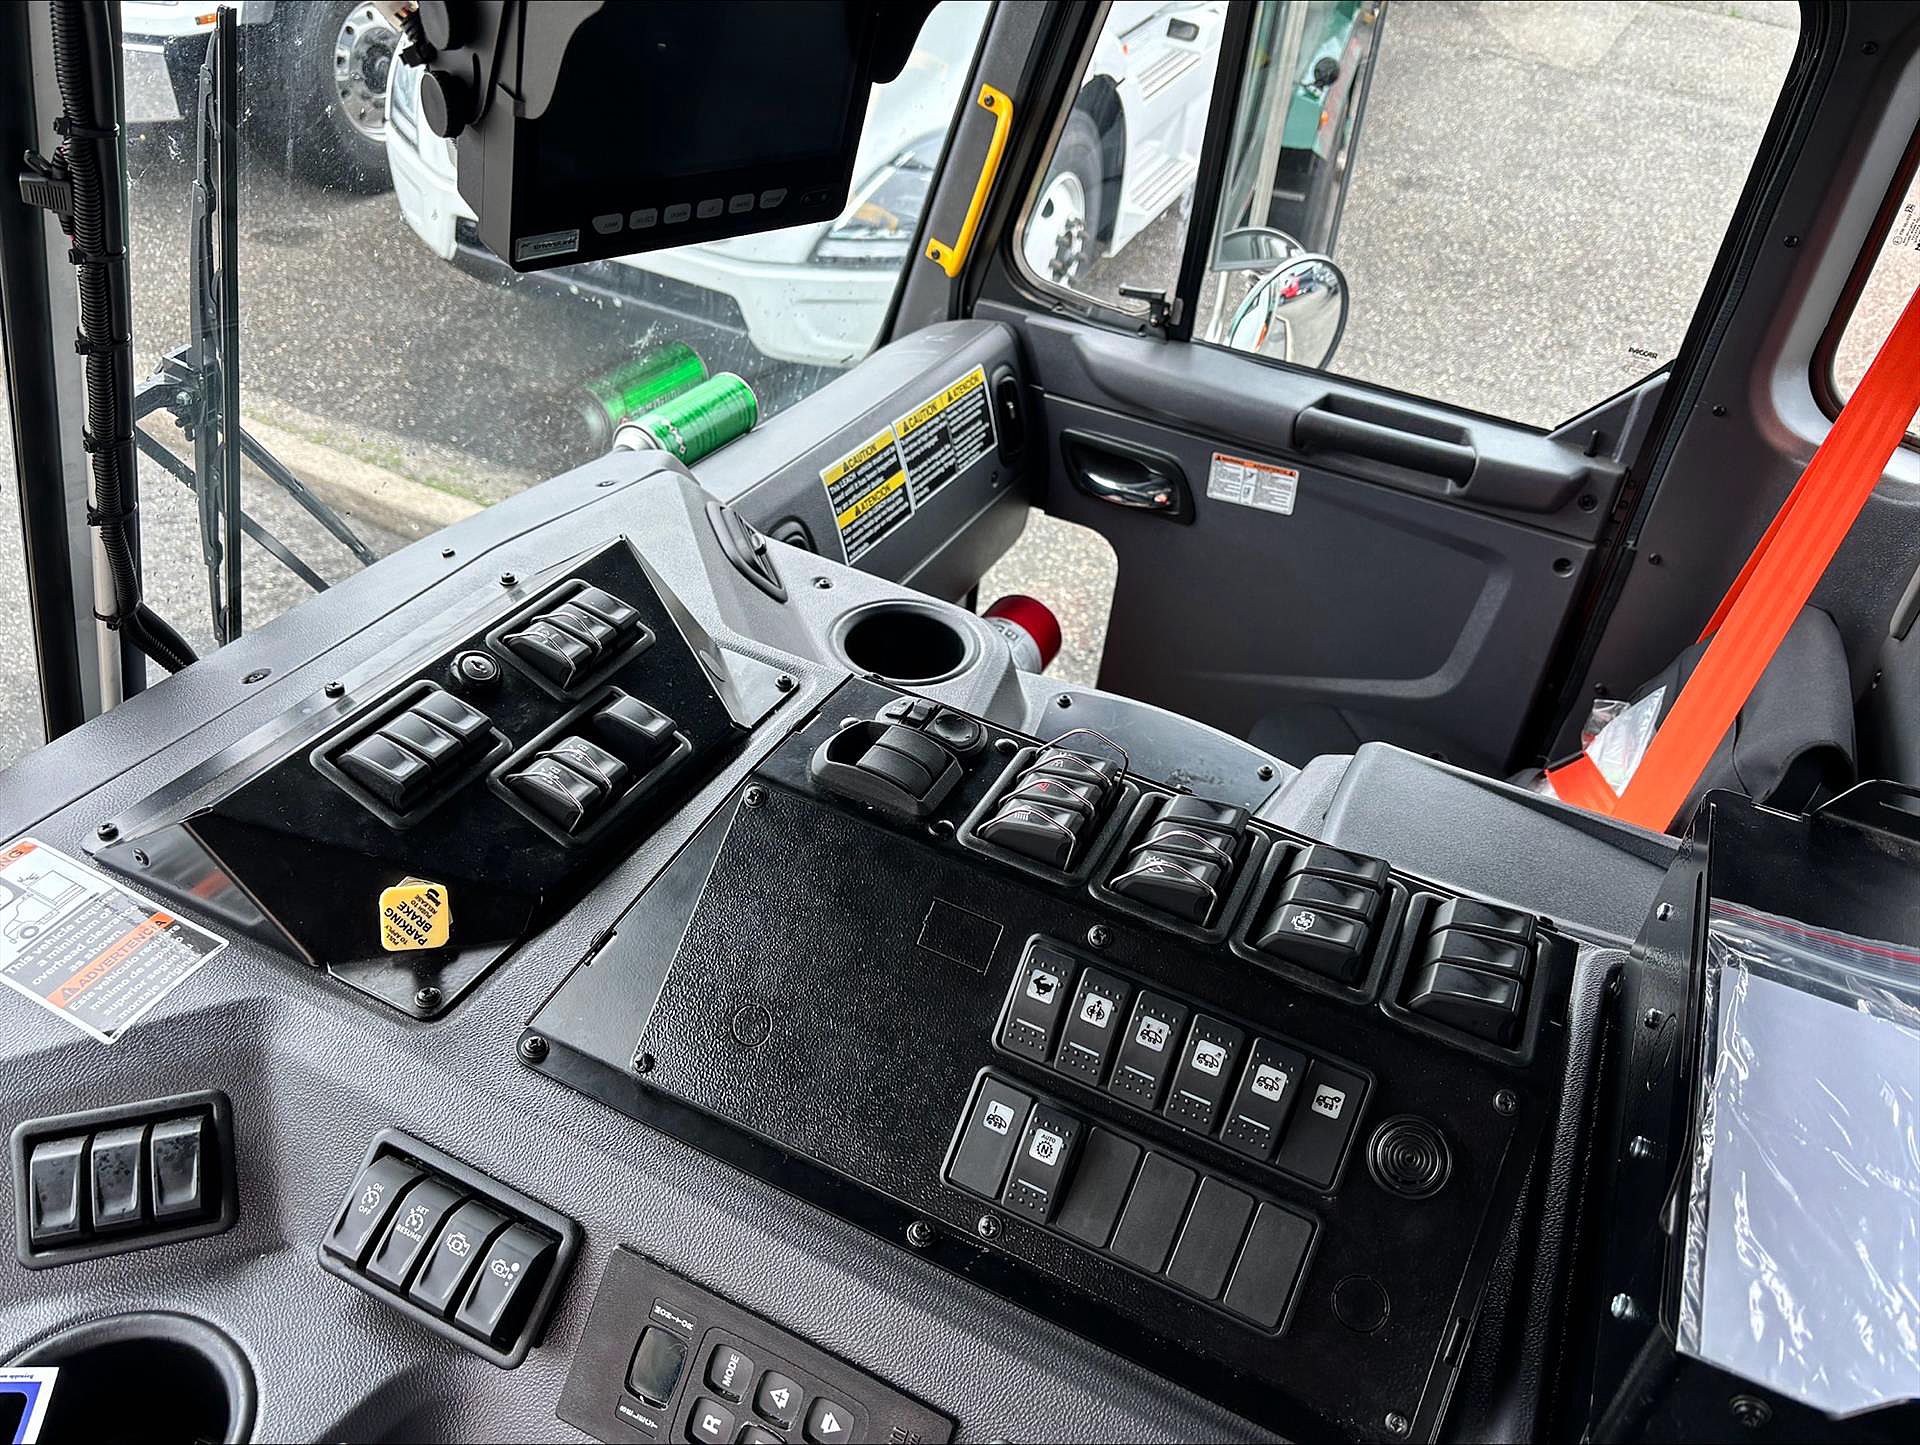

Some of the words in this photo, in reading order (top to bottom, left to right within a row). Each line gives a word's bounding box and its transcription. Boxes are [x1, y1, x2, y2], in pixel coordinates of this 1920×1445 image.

[908, 403, 937, 428] CAUTION
[847, 442, 877, 468] CAUTION
[410, 899, 418, 907] TO
[414, 894, 437, 915] RELEASE
[383, 906, 428, 946] PARKING
[396, 900, 432, 932] BRAKE
[37, 957, 48, 967] a
[44, 919, 99, 958] minimum
[99, 908, 112, 918] of
[384, 924, 401, 939] APPLY
[385, 932, 399, 945] PULL
[399, 936, 407, 944] TO
[5, 954, 33, 973] This
[33, 923, 74, 953] vehicle
[68, 960, 84, 970] as
[82, 927, 125, 958] shown.
[77, 920, 166, 986] ADVERTENCIA
[30, 943, 86, 983] overhead
[128, 966, 144, 978] de
[69, 990, 96, 1010] Este
[102, 979, 148, 1015] superior
[373, 1183, 384, 1192] ON
[359, 1205, 371, 1215] OFF
[416, 1205, 429, 1215] SET
[396, 1223, 421, 1242] RESUME
[722, 1353, 740, 1387] MODE
[619, 1405, 658, 1429] SELECT
[702, 1414, 722, 1435] R
